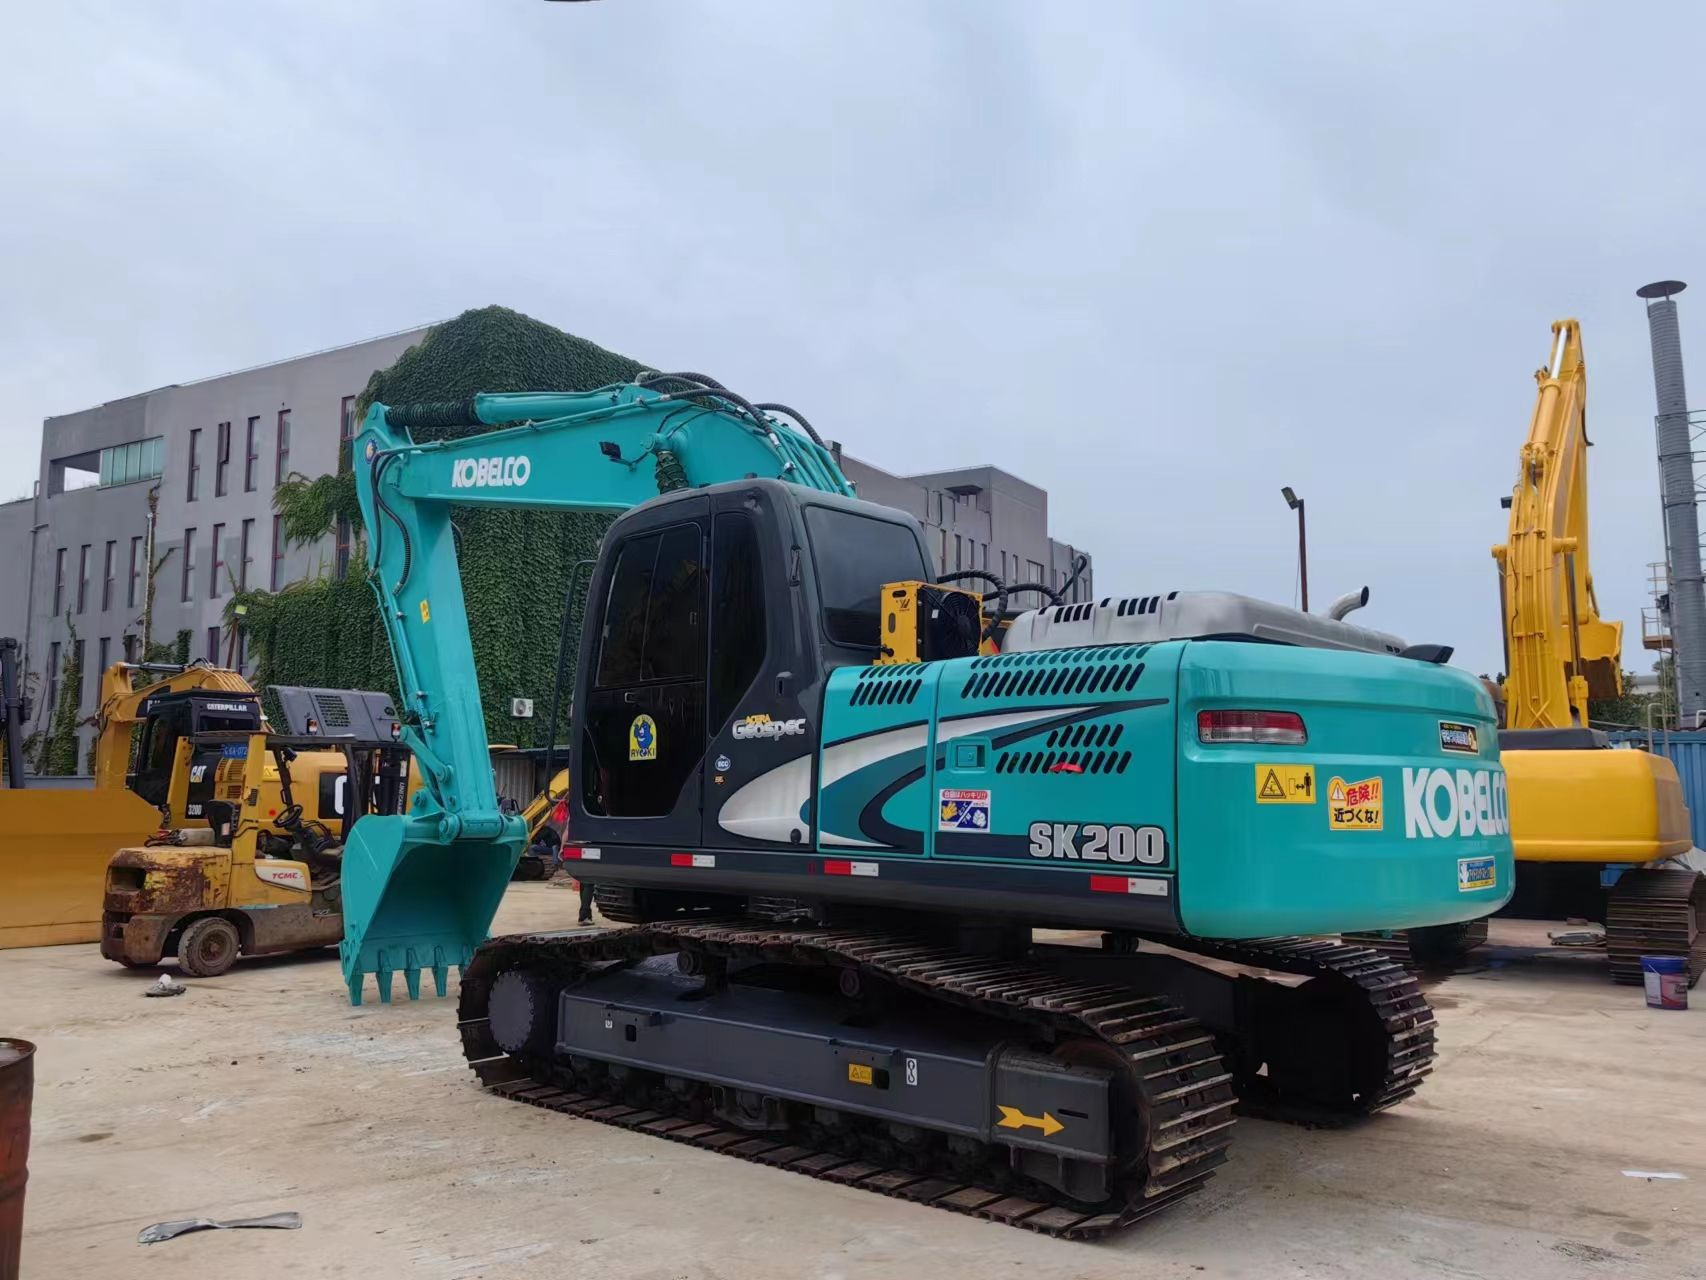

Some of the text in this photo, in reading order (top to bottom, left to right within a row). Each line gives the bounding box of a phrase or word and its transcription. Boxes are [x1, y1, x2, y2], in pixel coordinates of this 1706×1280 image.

[451, 455, 531, 488] KOBELCO
[206, 703, 248, 712] CATERPILLAR
[190, 765, 207, 782] CAT
[1402, 767, 1509, 838] KOBELCO
[1029, 822, 1165, 864] SK200
